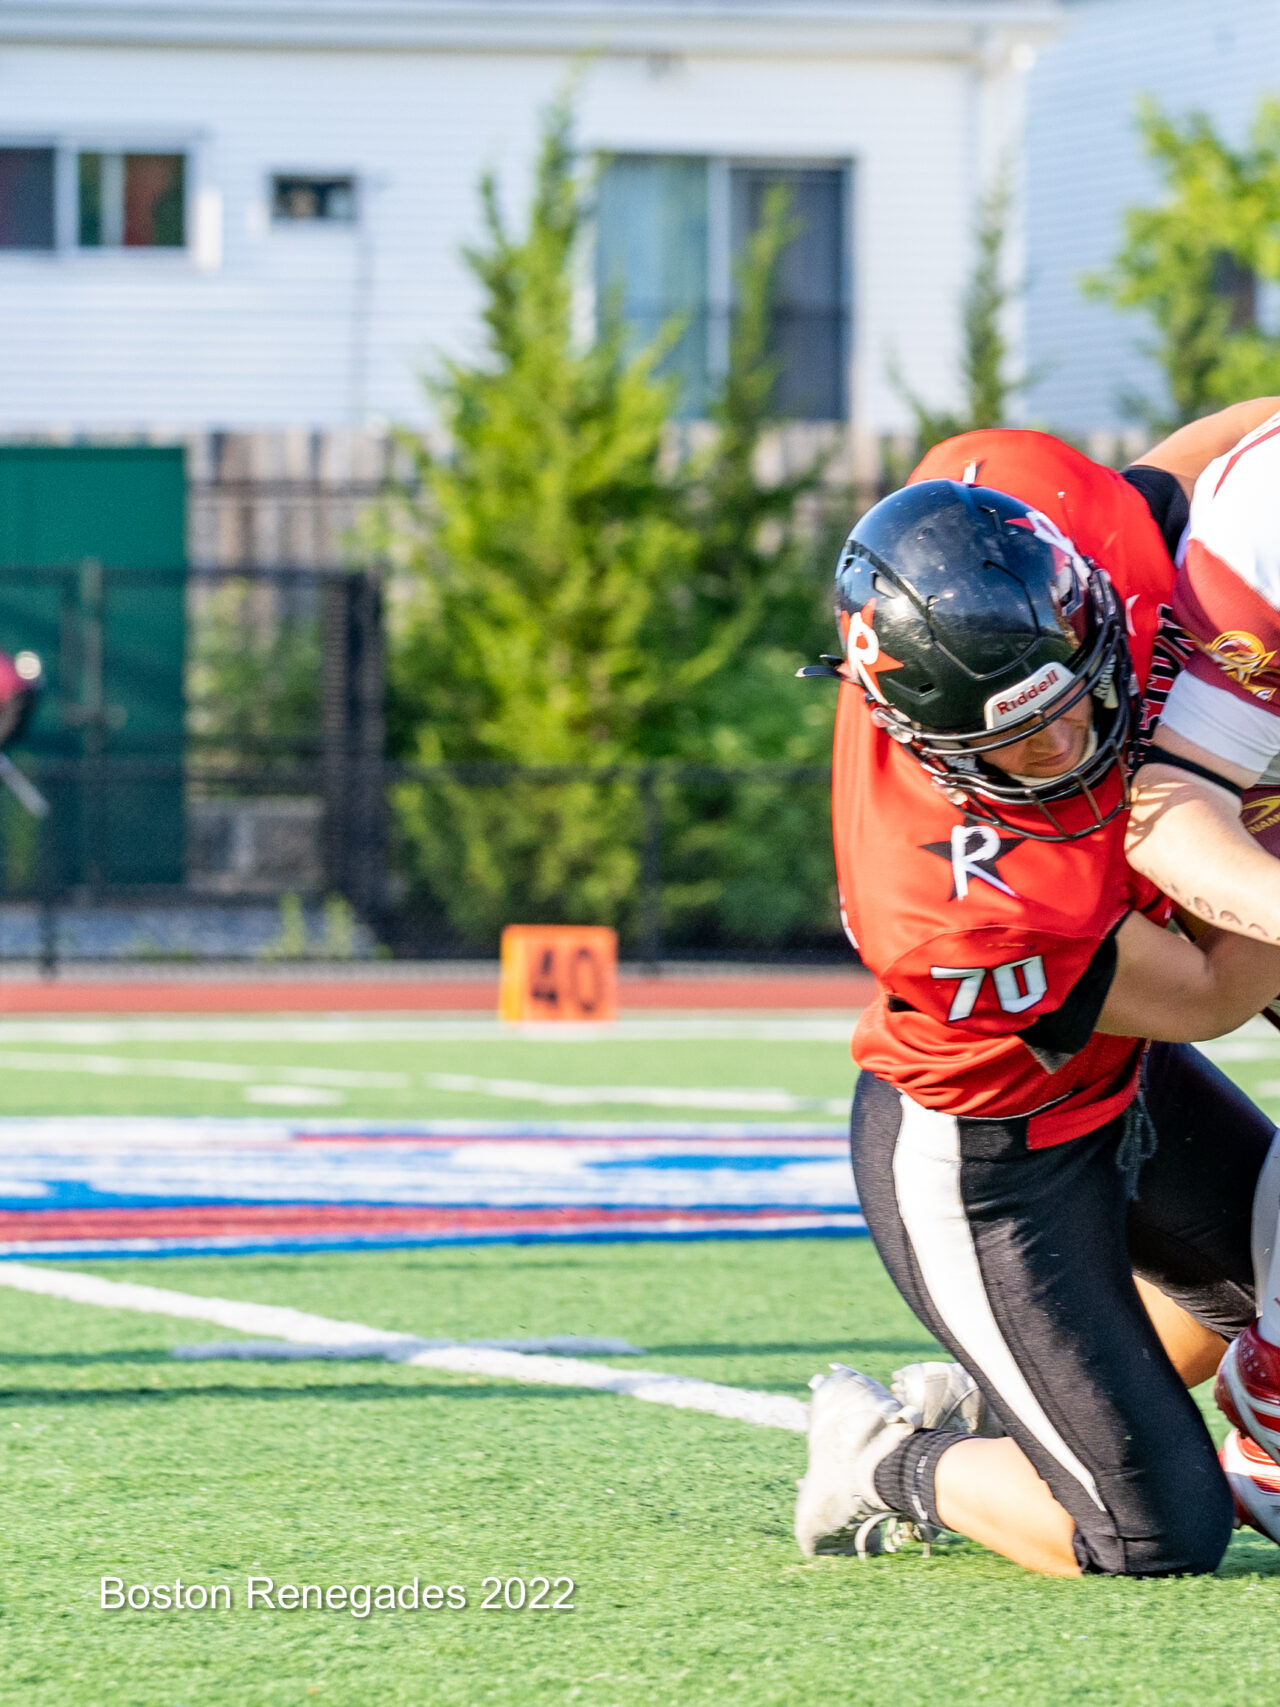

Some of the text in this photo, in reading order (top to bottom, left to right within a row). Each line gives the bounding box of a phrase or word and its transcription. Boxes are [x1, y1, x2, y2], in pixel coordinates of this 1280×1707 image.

[995, 669, 1060, 716] Riddell
[951, 825, 1022, 902] R
[531, 947, 604, 1014] 40
[930, 954, 1048, 1022] 70
